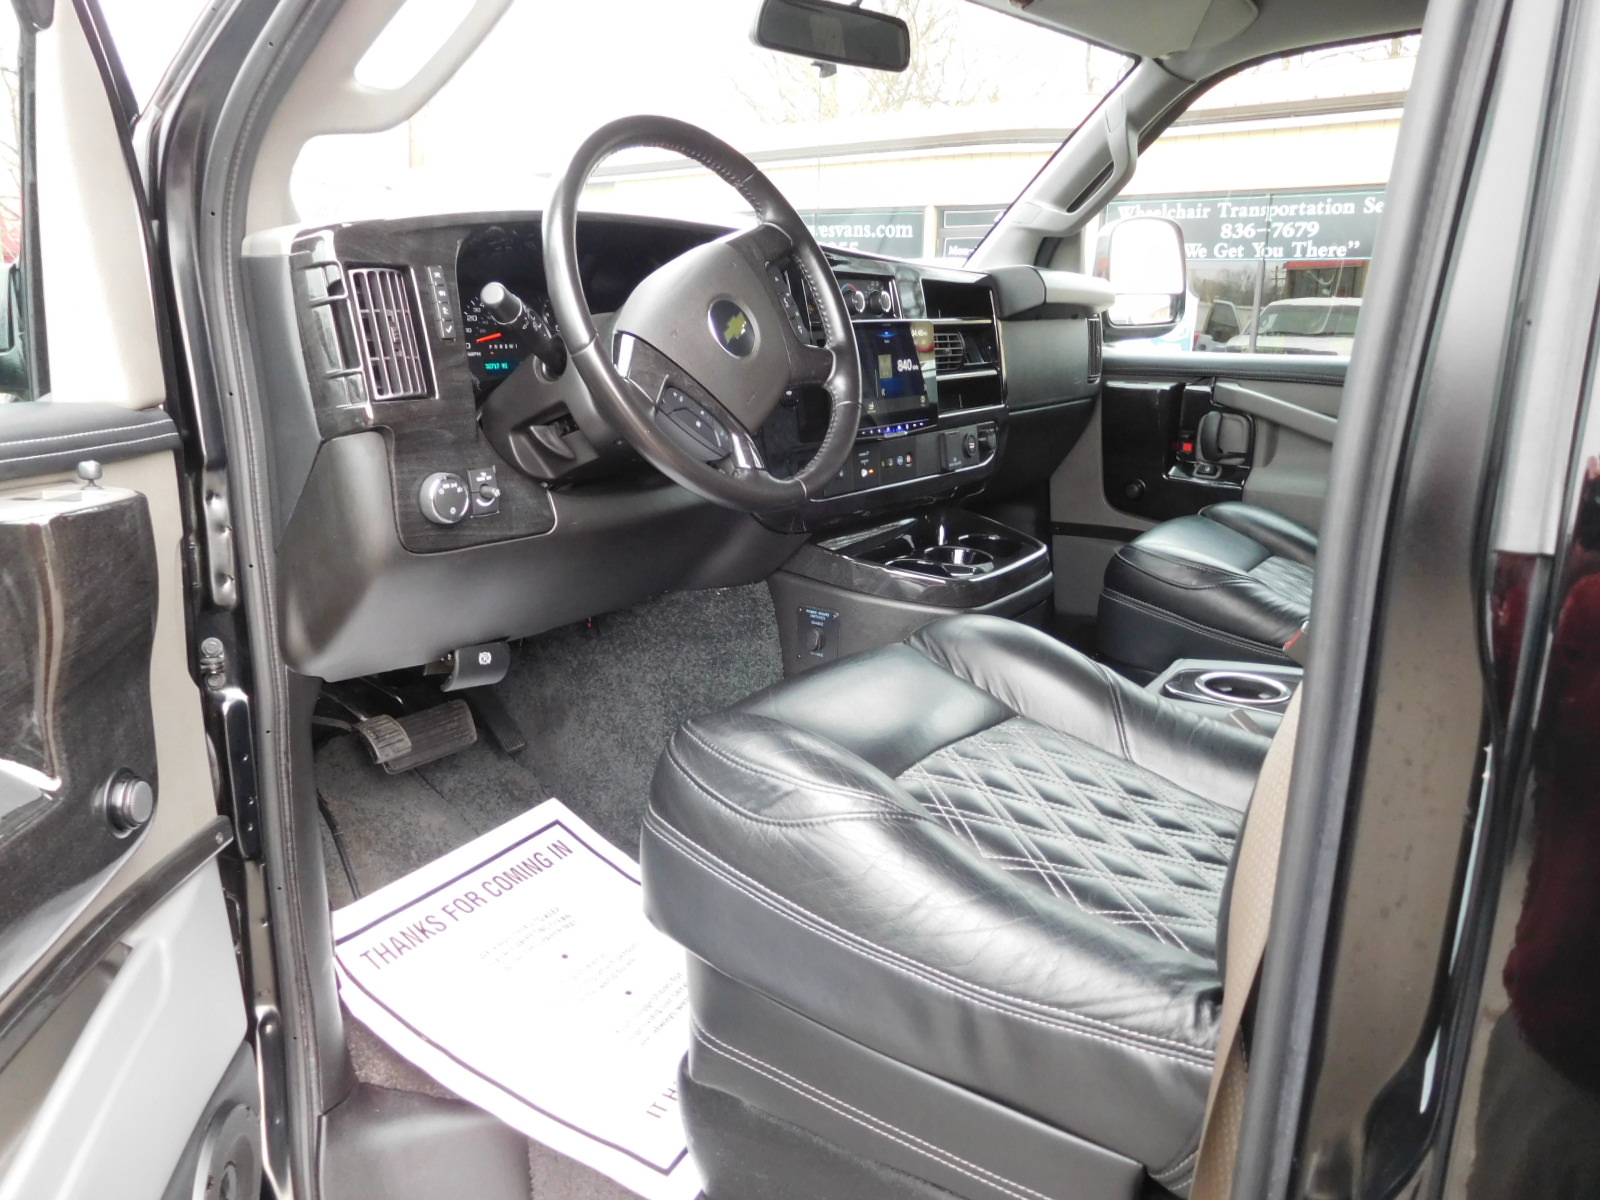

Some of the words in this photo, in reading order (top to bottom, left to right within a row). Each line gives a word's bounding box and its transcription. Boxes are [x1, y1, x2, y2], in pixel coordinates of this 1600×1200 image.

[1217, 198, 1355, 220] Transportation
[1220, 221, 1320, 239] 836-7679
[1213, 241, 1245, 258] Get
[1251, 241, 1284, 258] You
[360, 915, 447, 970] THANKS
[442, 891, 488, 922] FOR
[482, 851, 555, 898] COMING
[547, 839, 574, 860] IN
